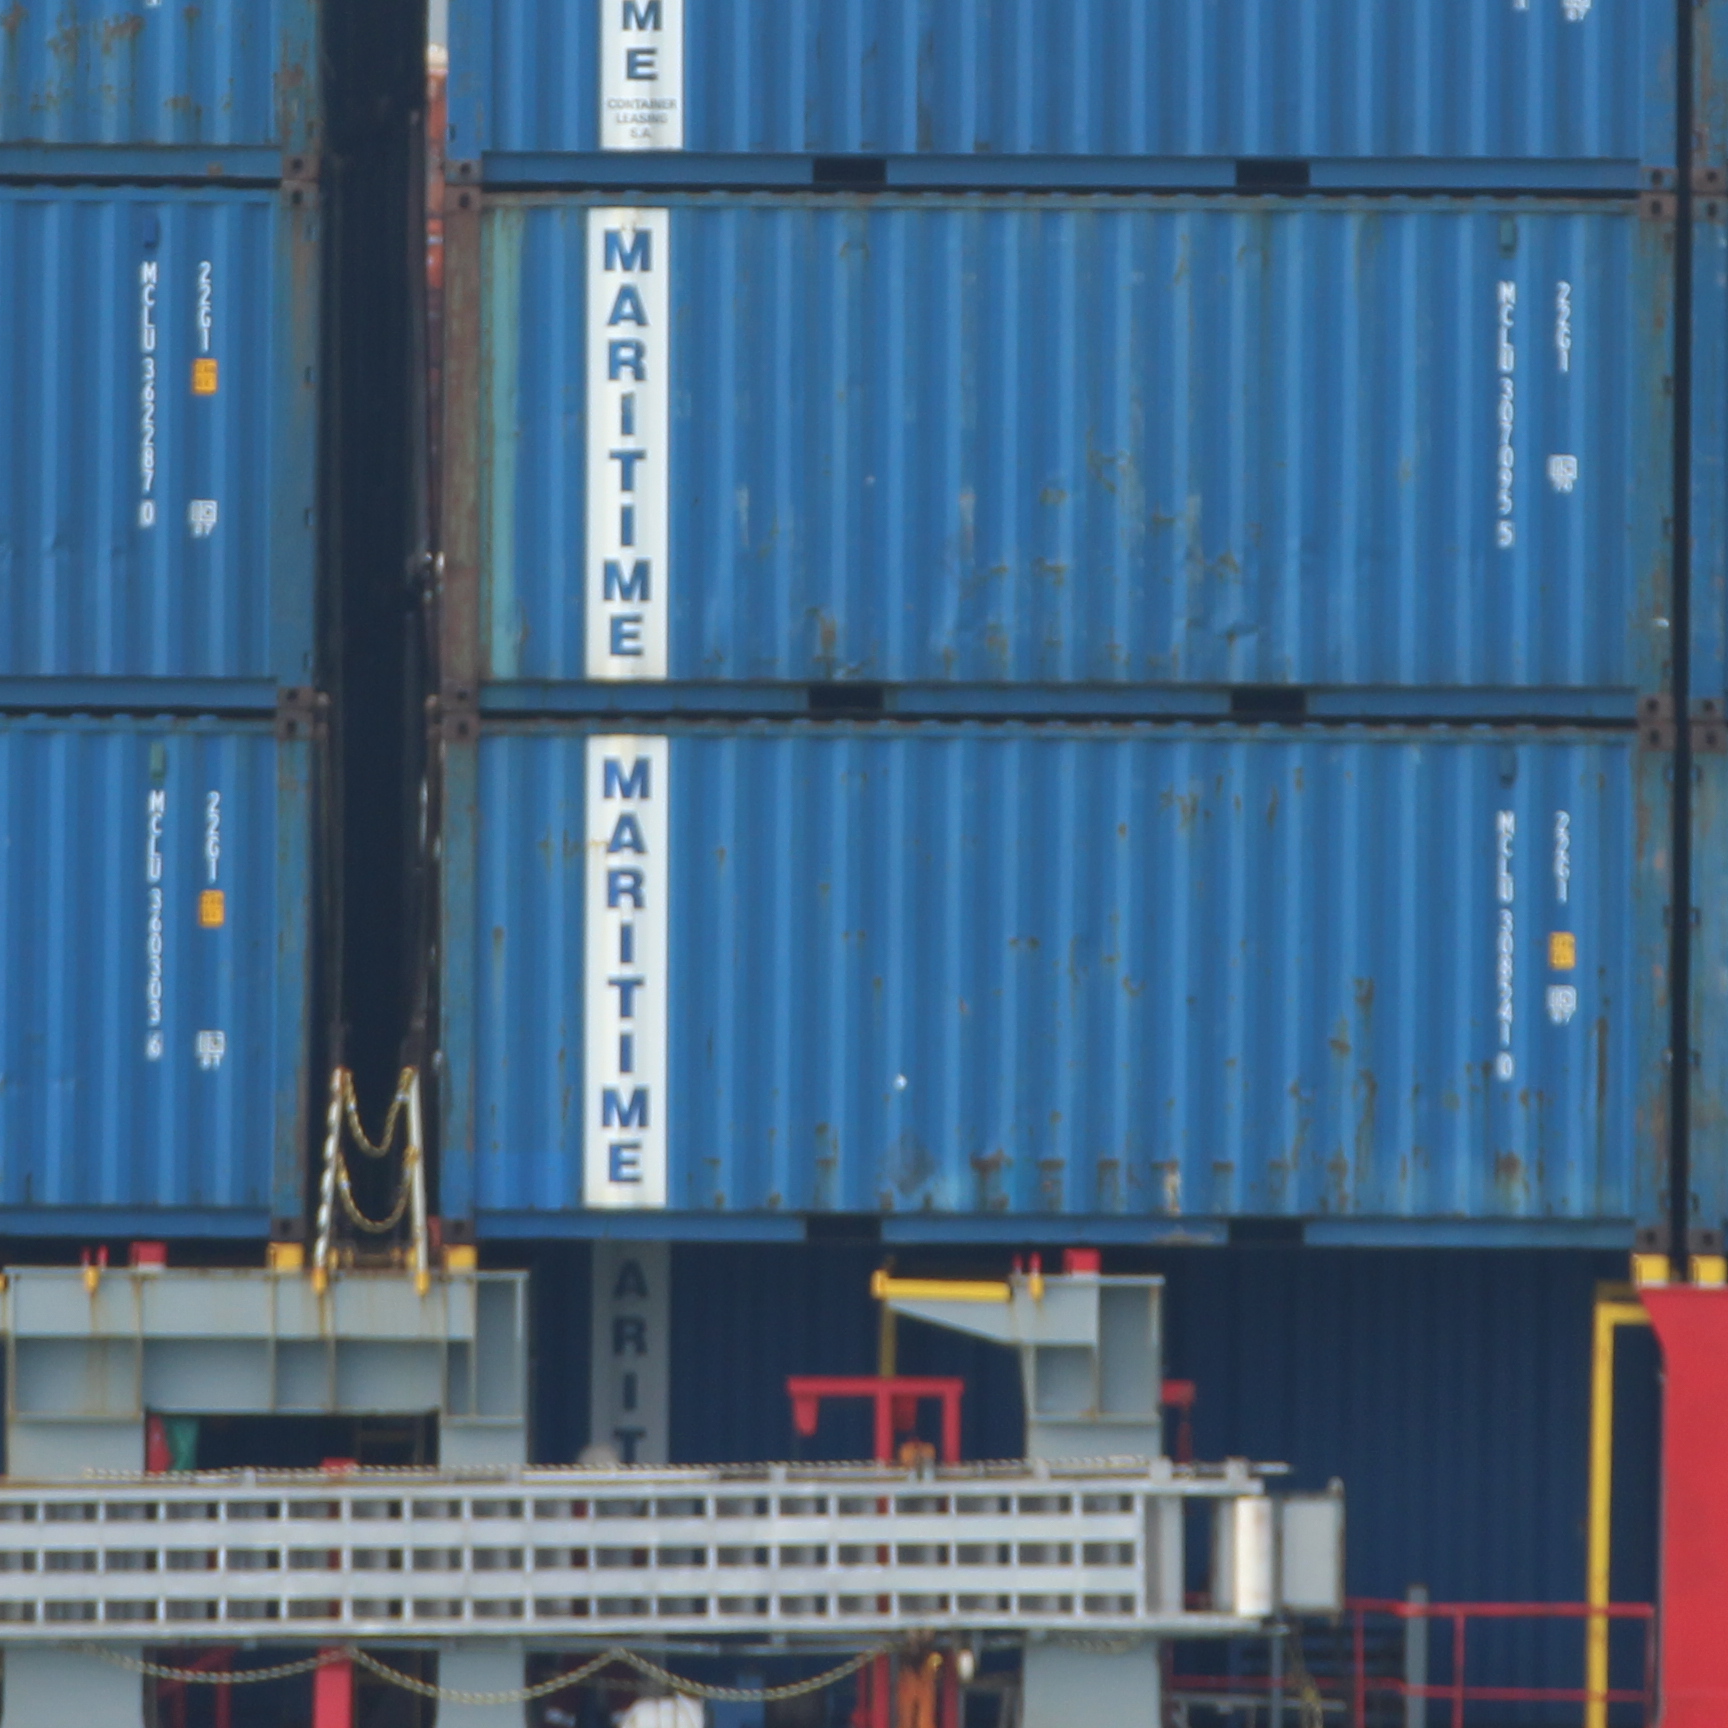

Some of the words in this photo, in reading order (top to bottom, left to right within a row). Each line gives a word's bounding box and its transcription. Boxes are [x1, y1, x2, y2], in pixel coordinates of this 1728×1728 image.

[607, 99, 676, 109] CONTAINER
[616, 112, 668, 124] LEASING
[141, 263, 159, 354] MCLU
[199, 262, 212, 353] 22G1
[1499, 282, 1517, 374] MCLU
[1557, 282, 1572, 373] 22G1
[142, 358, 156, 492] 362287
[602, 227, 653, 658] MARITIME
[1500, 378, 1515, 515] 307095
[140, 501, 157, 528] 0
[1499, 521, 1516, 548] 5
[148, 791, 166, 883] MCLU
[207, 792, 221, 881] 22G1
[1498, 812, 1516, 904] MCLU
[1556, 812, 1571, 902] 22G1
[148, 888, 163, 1027] 360303
[601, 755, 652, 1184] MARITIME
[147, 1033, 164, 1060] 6
[1498, 1053, 1515, 1081] 0
